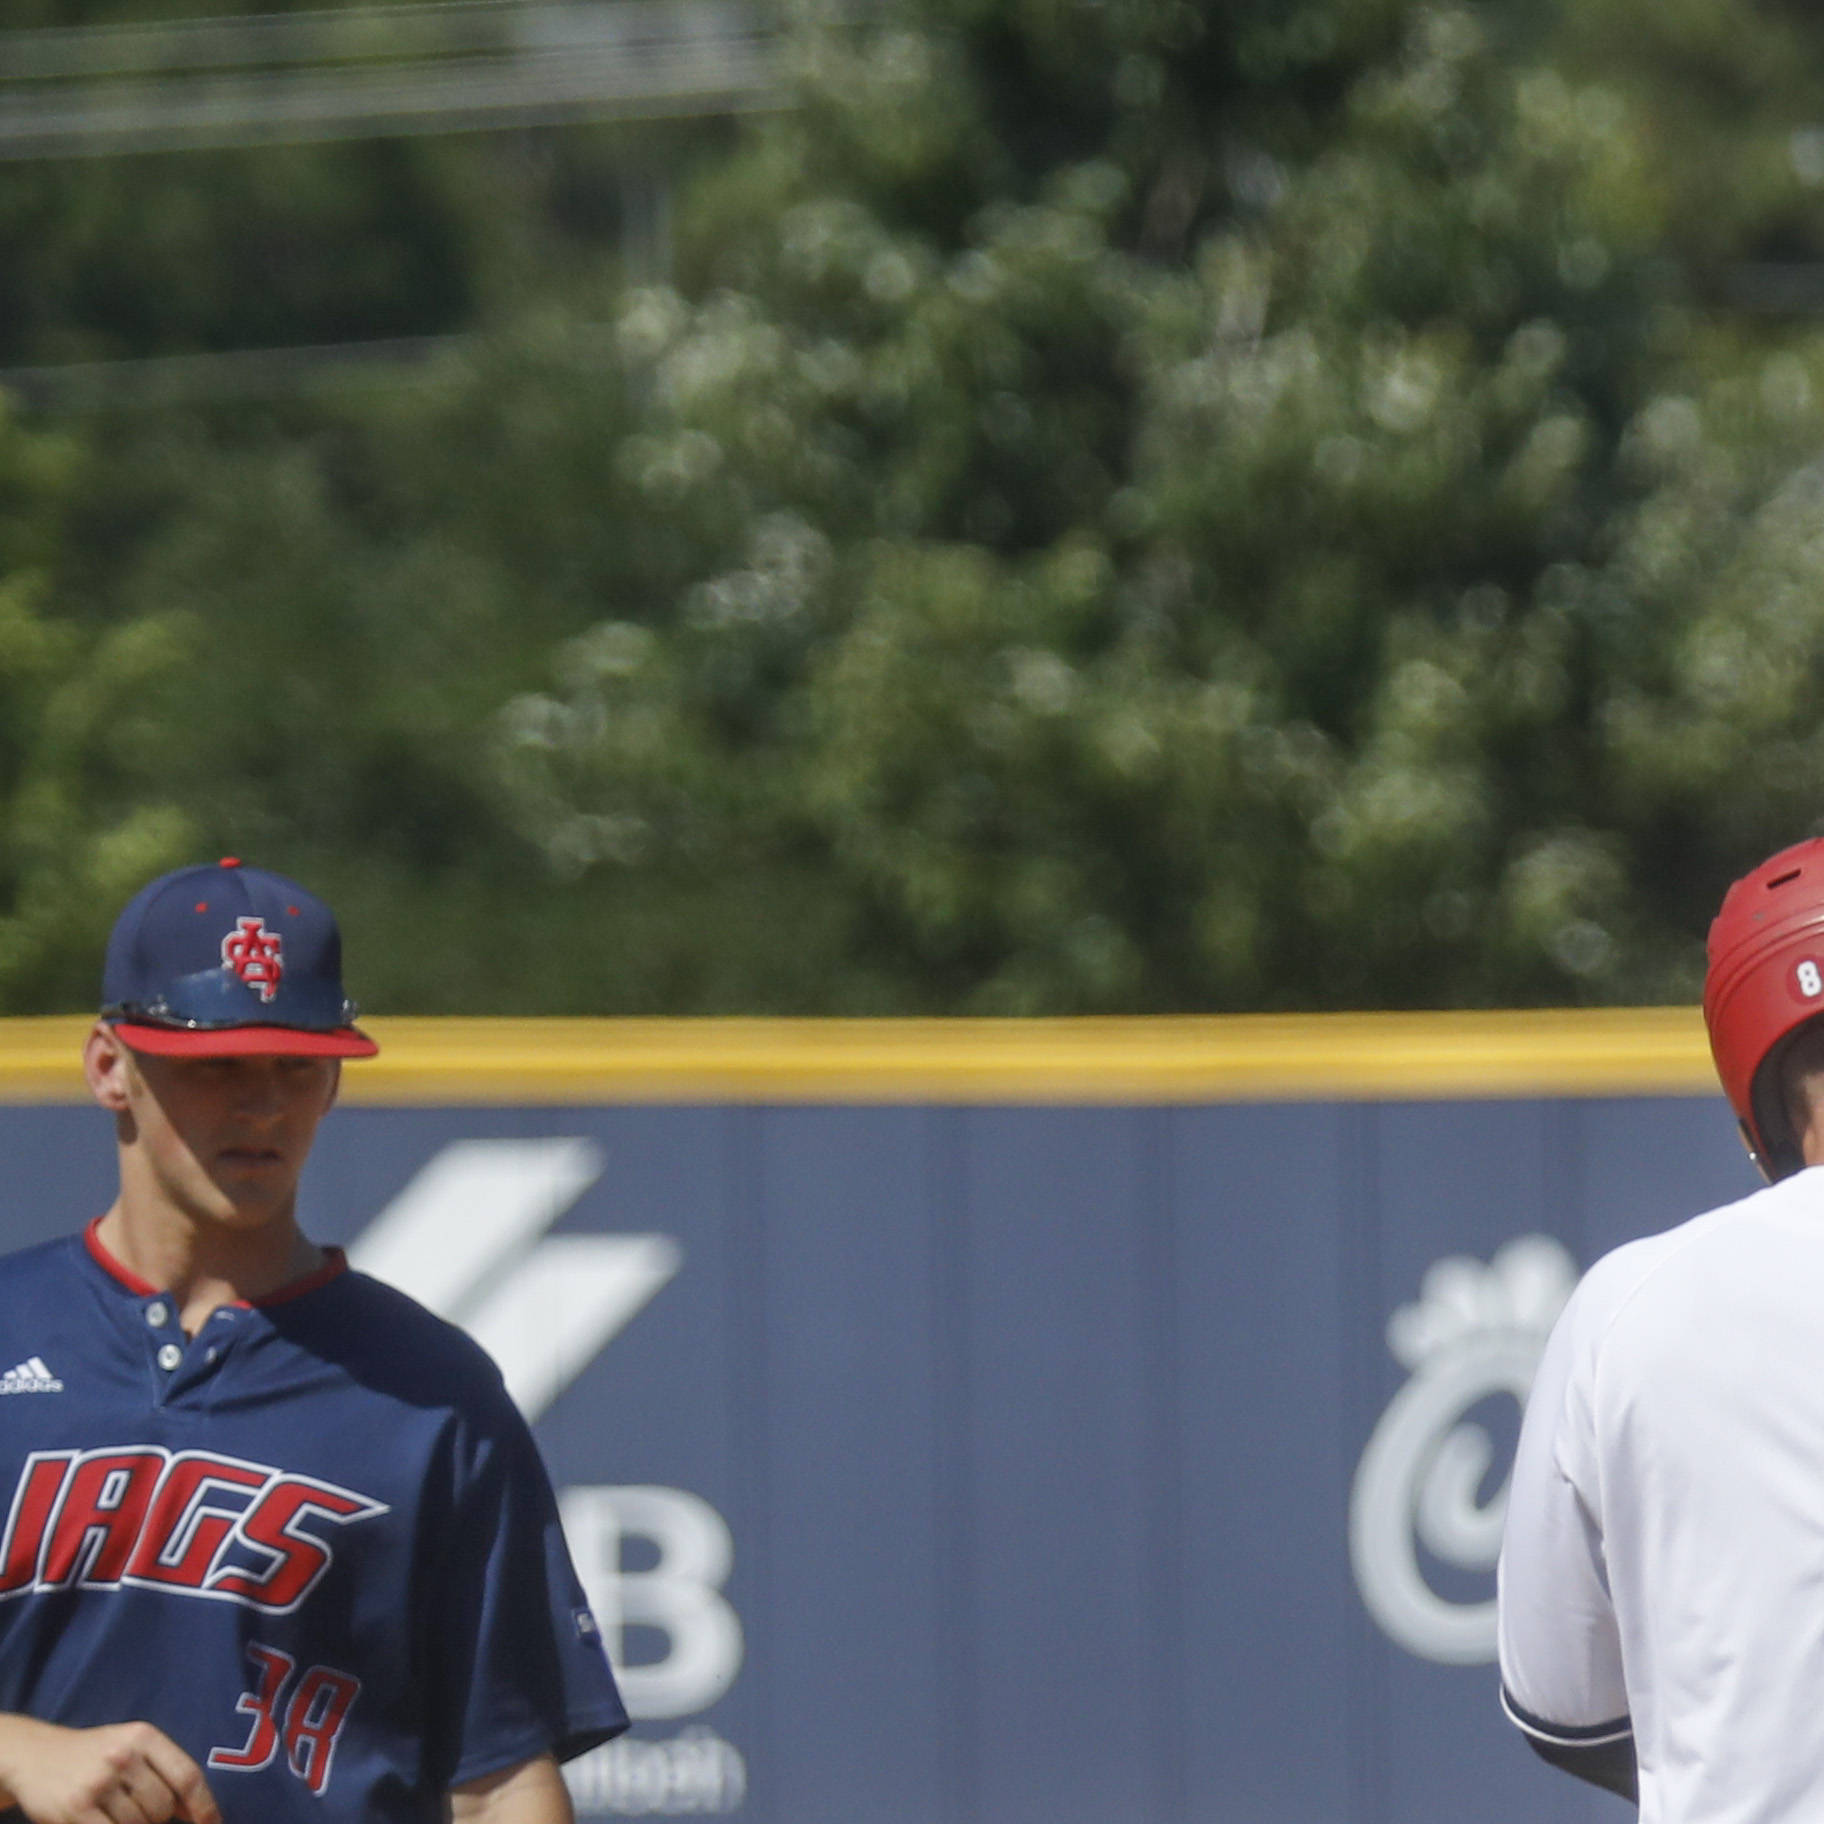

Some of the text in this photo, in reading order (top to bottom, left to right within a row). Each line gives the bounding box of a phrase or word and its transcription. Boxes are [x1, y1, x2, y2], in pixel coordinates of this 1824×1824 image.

[1796, 960, 1824, 998] 8
[0, 1444, 390, 1616] JAGS
[207, 1640, 361, 1797] 38
